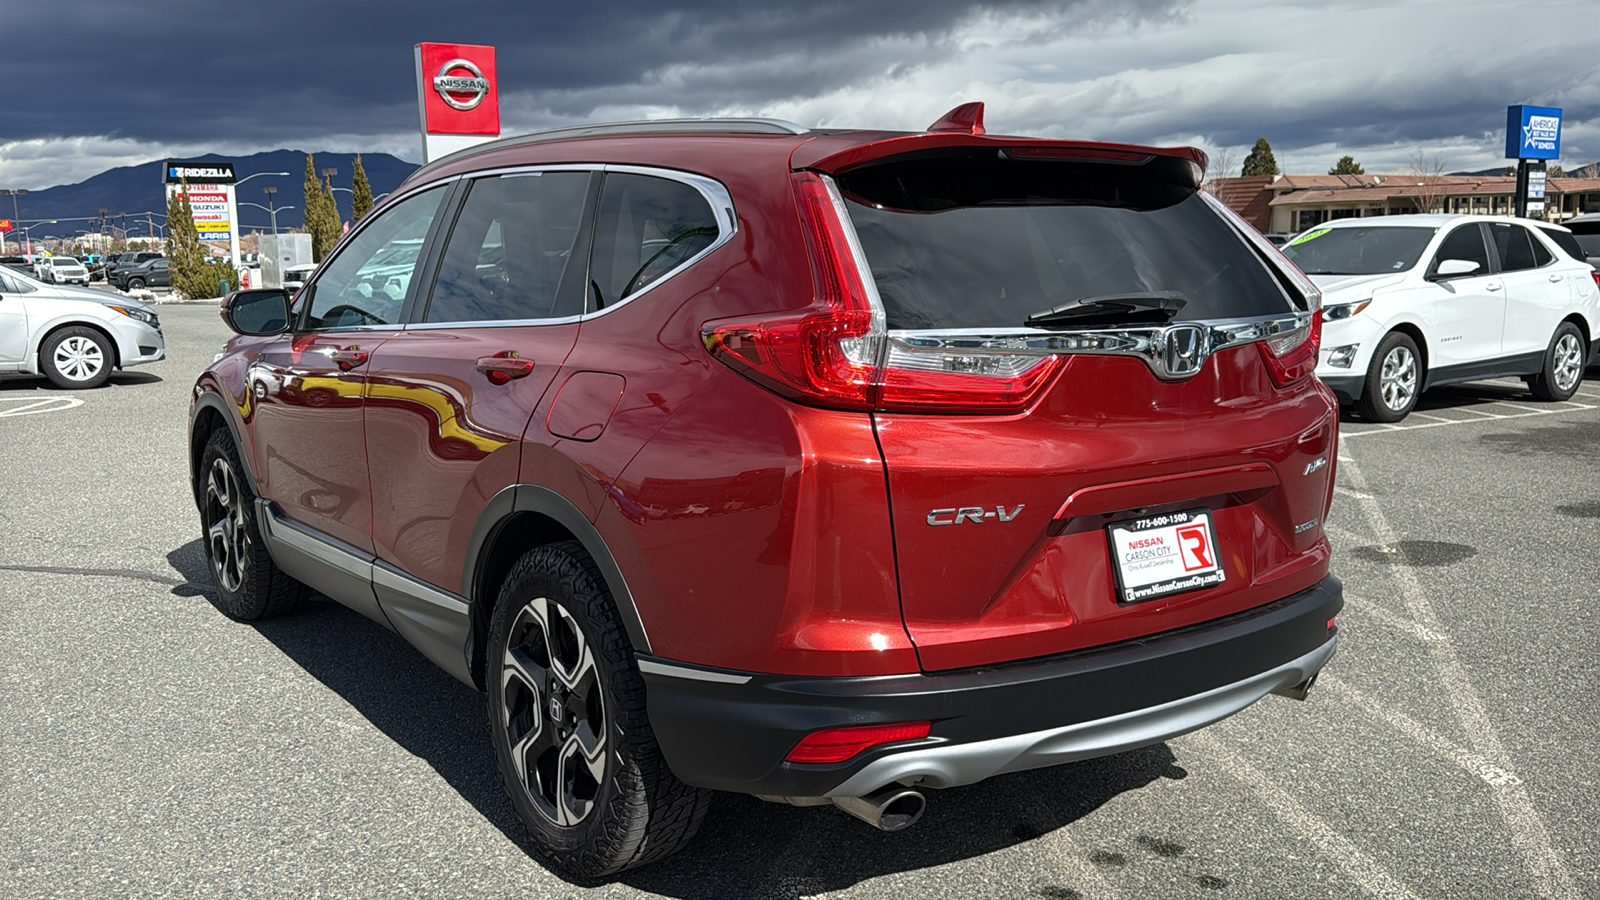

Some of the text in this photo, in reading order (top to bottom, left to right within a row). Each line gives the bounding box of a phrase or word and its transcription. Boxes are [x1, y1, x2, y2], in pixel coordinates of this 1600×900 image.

[440, 79, 485, 89] NISSAN
[184, 168, 233, 177] RIDEZILLA
[926, 503, 1026, 526] CR-V
[1136, 513, 1188, 529] 775-600-1500
[1128, 536, 1164, 550] NISSAN
[1125, 545, 1171, 563] CARSON CITY
[1134, 573, 1218, 598] www.NissanCarsonCity.com
